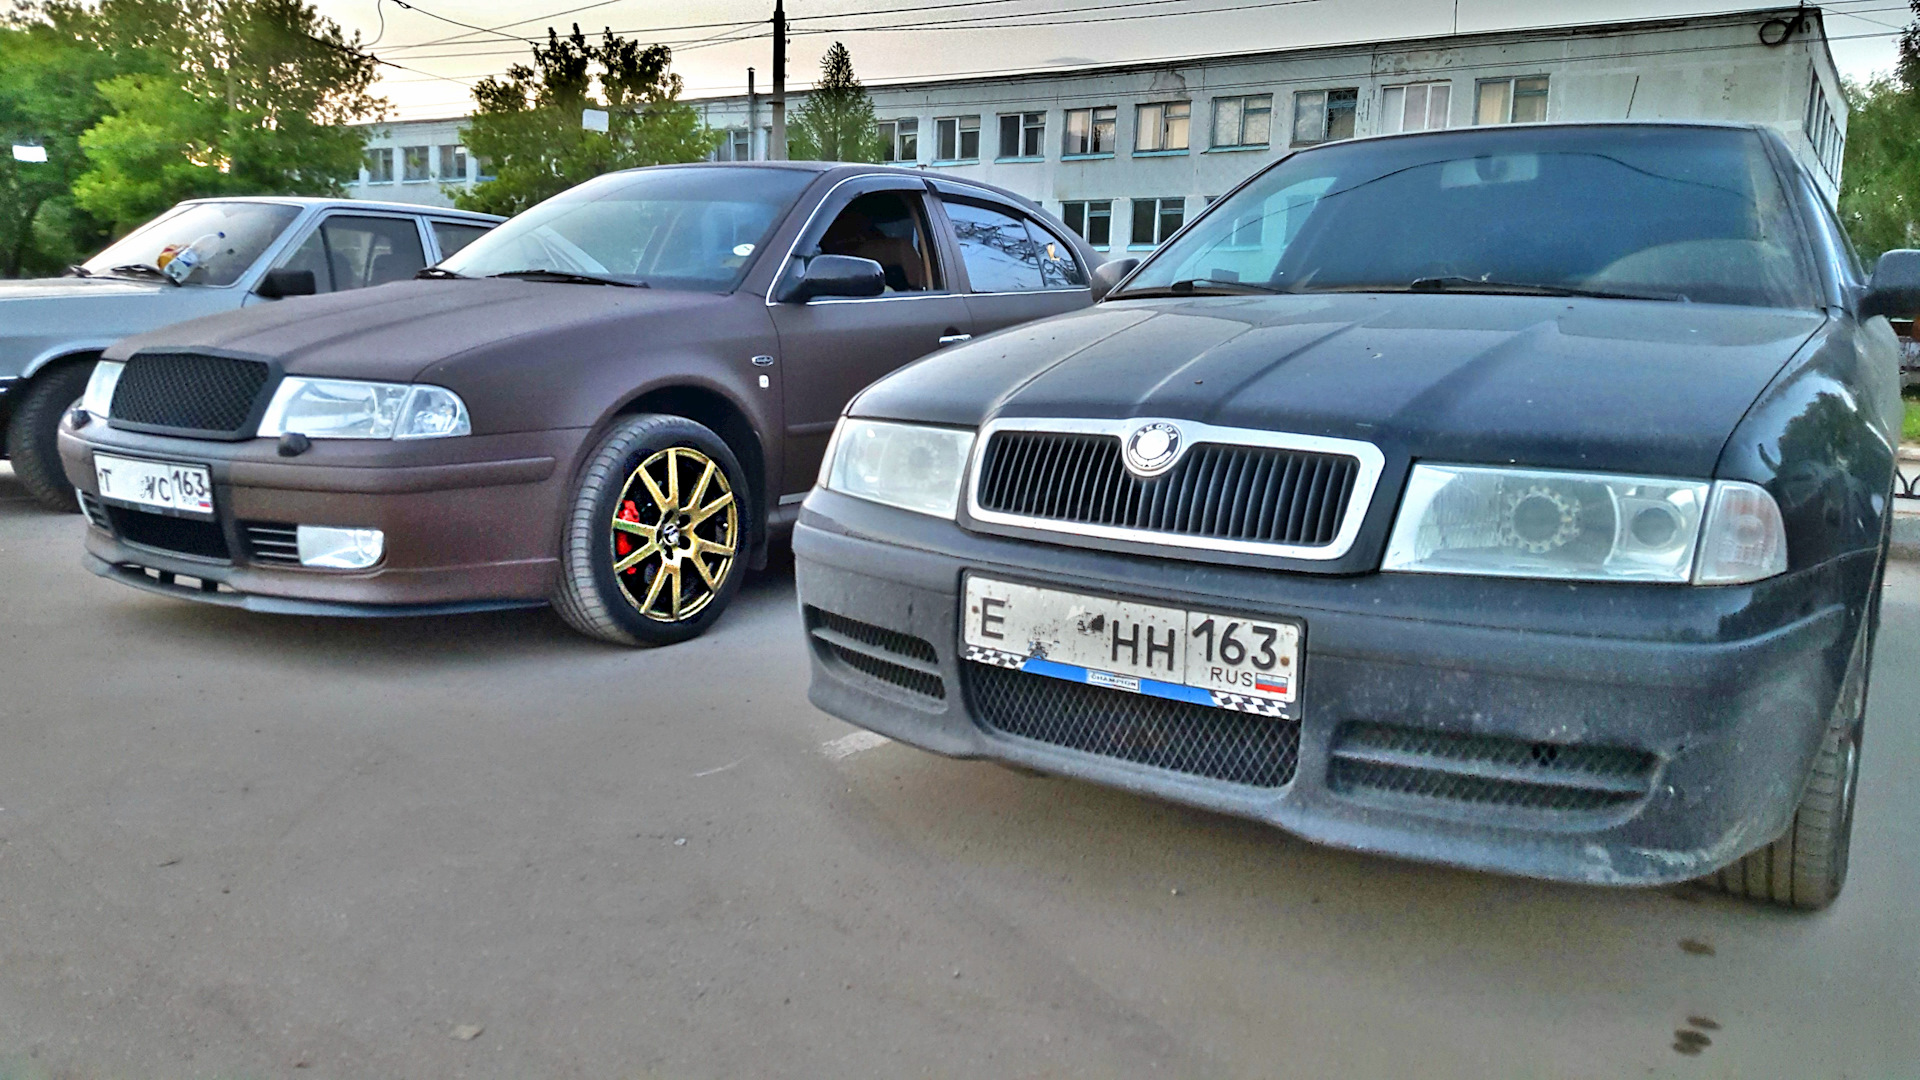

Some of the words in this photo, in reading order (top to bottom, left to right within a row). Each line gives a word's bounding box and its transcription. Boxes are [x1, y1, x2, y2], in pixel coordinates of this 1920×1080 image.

[172, 470, 206, 497] 163
[981, 597, 1005, 640] E
[1111, 620, 1176, 671] HH
[1192, 619, 1278, 670] 163
[1210, 666, 1253, 687] RUS
